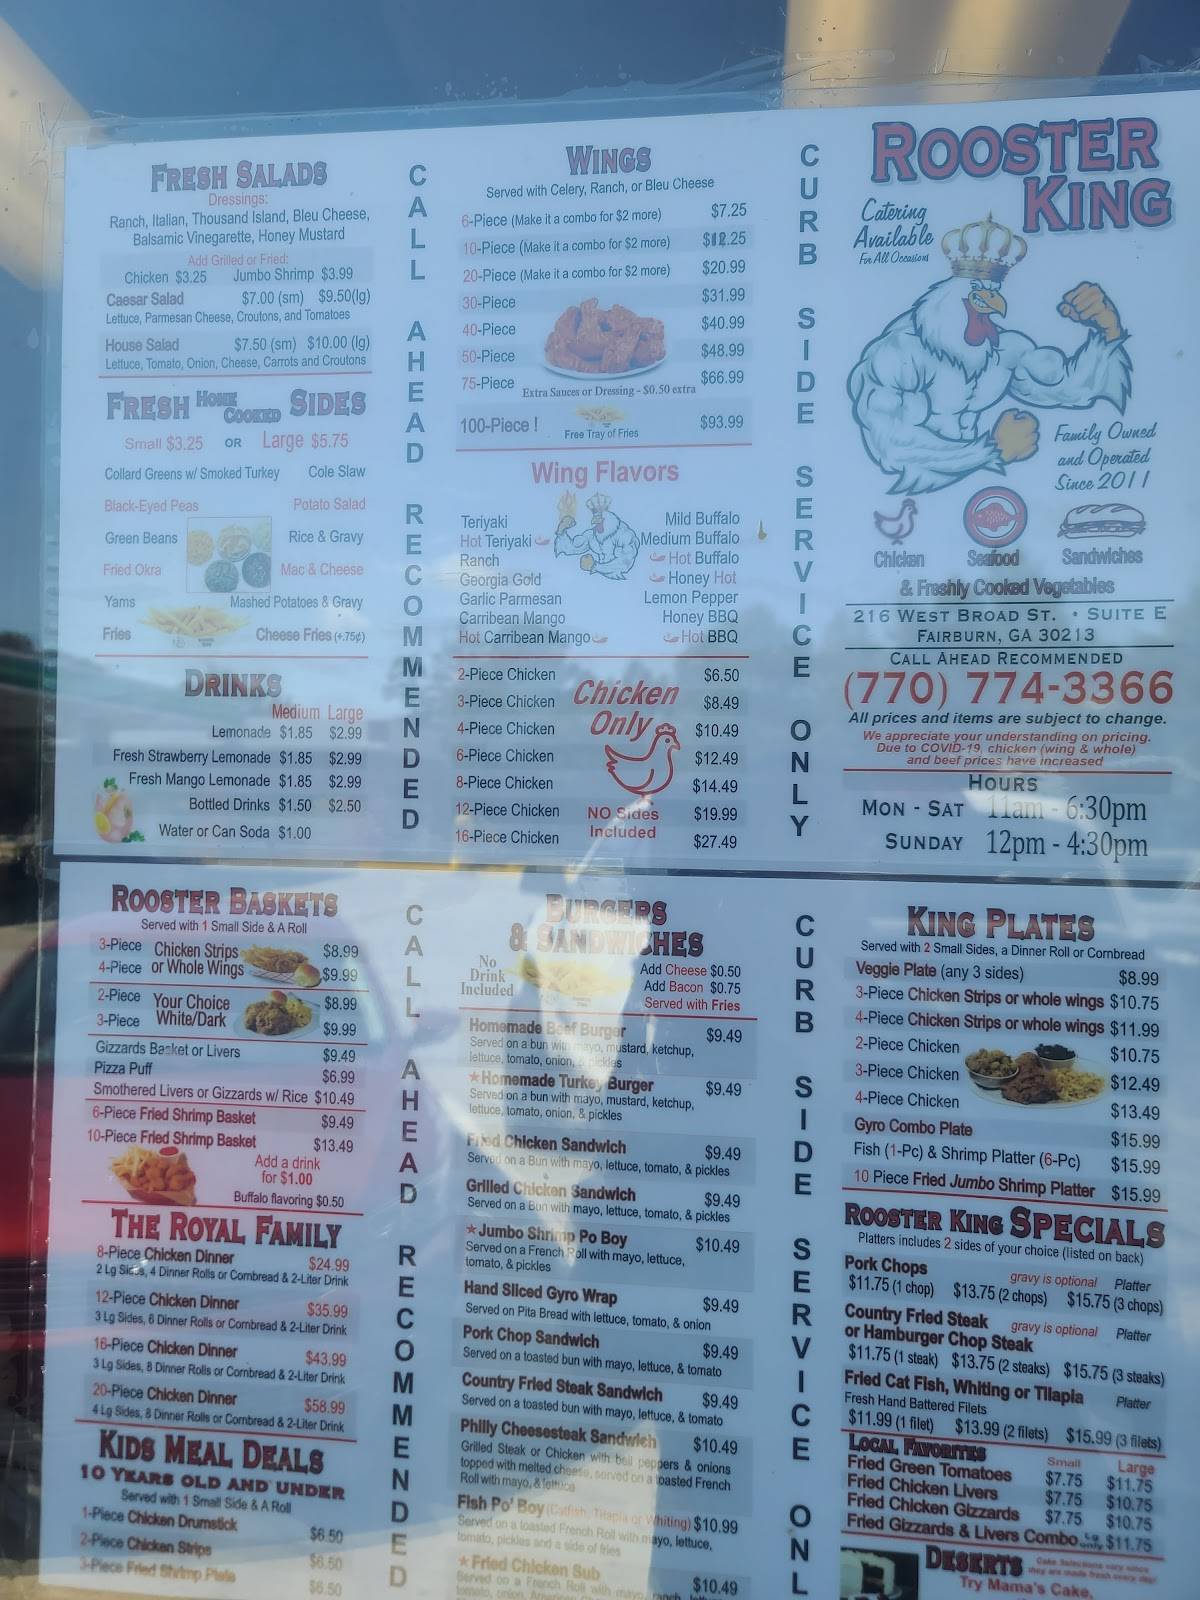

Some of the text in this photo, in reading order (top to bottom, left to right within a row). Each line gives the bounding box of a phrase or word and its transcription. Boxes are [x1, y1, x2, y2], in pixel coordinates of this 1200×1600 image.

[871, 118, 1160, 183] ROOSTER
[566, 145, 651, 175] WINGS
[151, 160, 328, 192] FRESH SALADS
[486, 177, 714, 199] Served with Celery, Ranch, or Bleu Cheese
[208, 193, 269, 208] Dressings:
[798, 145, 819, 266] CURB
[861, 198, 927, 221] Catering
[1023, 175, 1173, 233] KING
[110, 208, 370, 230] Ranch, Italian, Thousand Island, Bleu Cheese,
[407, 165, 428, 281] CALL
[853, 224, 934, 250] Available
[124, 267, 353, 285] Chicken $3.25 Jumbo Shrimp $3.99
[463, 268, 516, 284] 20-Piece
[702, 260, 746, 276] $20.99
[462, 295, 516, 310] 30-Piece
[702, 288, 745, 303] $31.99
[796, 308, 816, 425] SIDE
[405, 321, 426, 464] AHEAD
[107, 391, 190, 421] FRESH
[289, 389, 366, 417] SIDES
[124, 430, 349, 452] Small $3.25 OR Large $5.75
[1054, 421, 1157, 443] Family Owned
[1057, 447, 1151, 471] and Operated
[308, 465, 366, 478] Cole Slaw
[531, 461, 680, 488] Wing Flavors
[1054, 471, 1151, 491] Since 2011
[461, 515, 508, 531] Teriyaki
[665, 511, 740, 526] Mild Buffalo
[289, 530, 363, 545] Rice & Gravy
[1062, 549, 1143, 565] Sandwiches
[792, 466, 814, 678] SERVICE
[644, 591, 739, 606] Lemon Pepper
[853, 606, 1167, 623] 216 WEST BROAD ST. SUITE E
[917, 628, 1095, 643] FAIRBURN, GA 30213
[401, 504, 424, 830] RECOMMENDED
[458, 668, 556, 681] 2-Piece Chicken
[704, 669, 740, 682] $6.50
[185, 669, 282, 698] DRINKS
[573, 680, 680, 705] Chicken
[844, 670, 1173, 711] (770) 774-3366
[272, 704, 363, 721] Medium Large
[849, 712, 1167, 727] All prices and items are subject to change.
[212, 726, 362, 740] Lemonade $1.85 $2.99
[590, 711, 654, 741] Only
[113, 749, 362, 766] Fresh Strawberry Lemonade $1.85 $2.99
[789, 719, 813, 836] ONLY
[968, 774, 1038, 791] HOURS
[189, 798, 361, 813] Bottled Drinks $1.50 $2.50
[862, 800, 905, 816] MON
[928, 800, 964, 817] SAT
[455, 830, 559, 845] 16-Piece Chicken
[693, 834, 737, 849] $27.49
[885, 833, 963, 850] SUNDAY
[987, 830, 1045, 861] 12pm
[1066, 831, 1148, 863] 4:30pm
[111, 884, 338, 917] ROOSTER BASKETS
[907, 906, 1095, 942] KING PLATES
[643, 980, 741, 995] Add Bacon $0.75
[153, 993, 230, 1011] Your Choice
[324, 996, 357, 1011] $8.99
[157, 1010, 227, 1028] White/Dark
[706, 1028, 742, 1043] $9.49
[855, 1036, 960, 1054] 2-Piece Chicken
[1110, 1048, 1160, 1064] $10.75
[111, 1208, 342, 1249] THE ROYAL FAMILY
[844, 1203, 1167, 1249] ROOSTER KING SPECIALS
[309, 1256, 350, 1272] $24.99
[1009, 1272, 1098, 1289] gravy is optional
[307, 1302, 348, 1318] $35.99
[463, 1325, 600, 1348] Pork Chop Sandwich
[702, 1344, 739, 1360] $9.49
[99, 1429, 325, 1475] KIDS MEAL DEALS
[848, 1454, 1012, 1482] Fried Green Tomatoes
[1046, 1471, 1083, 1487] $7.75
[1106, 1474, 1153, 1492] $11.75
